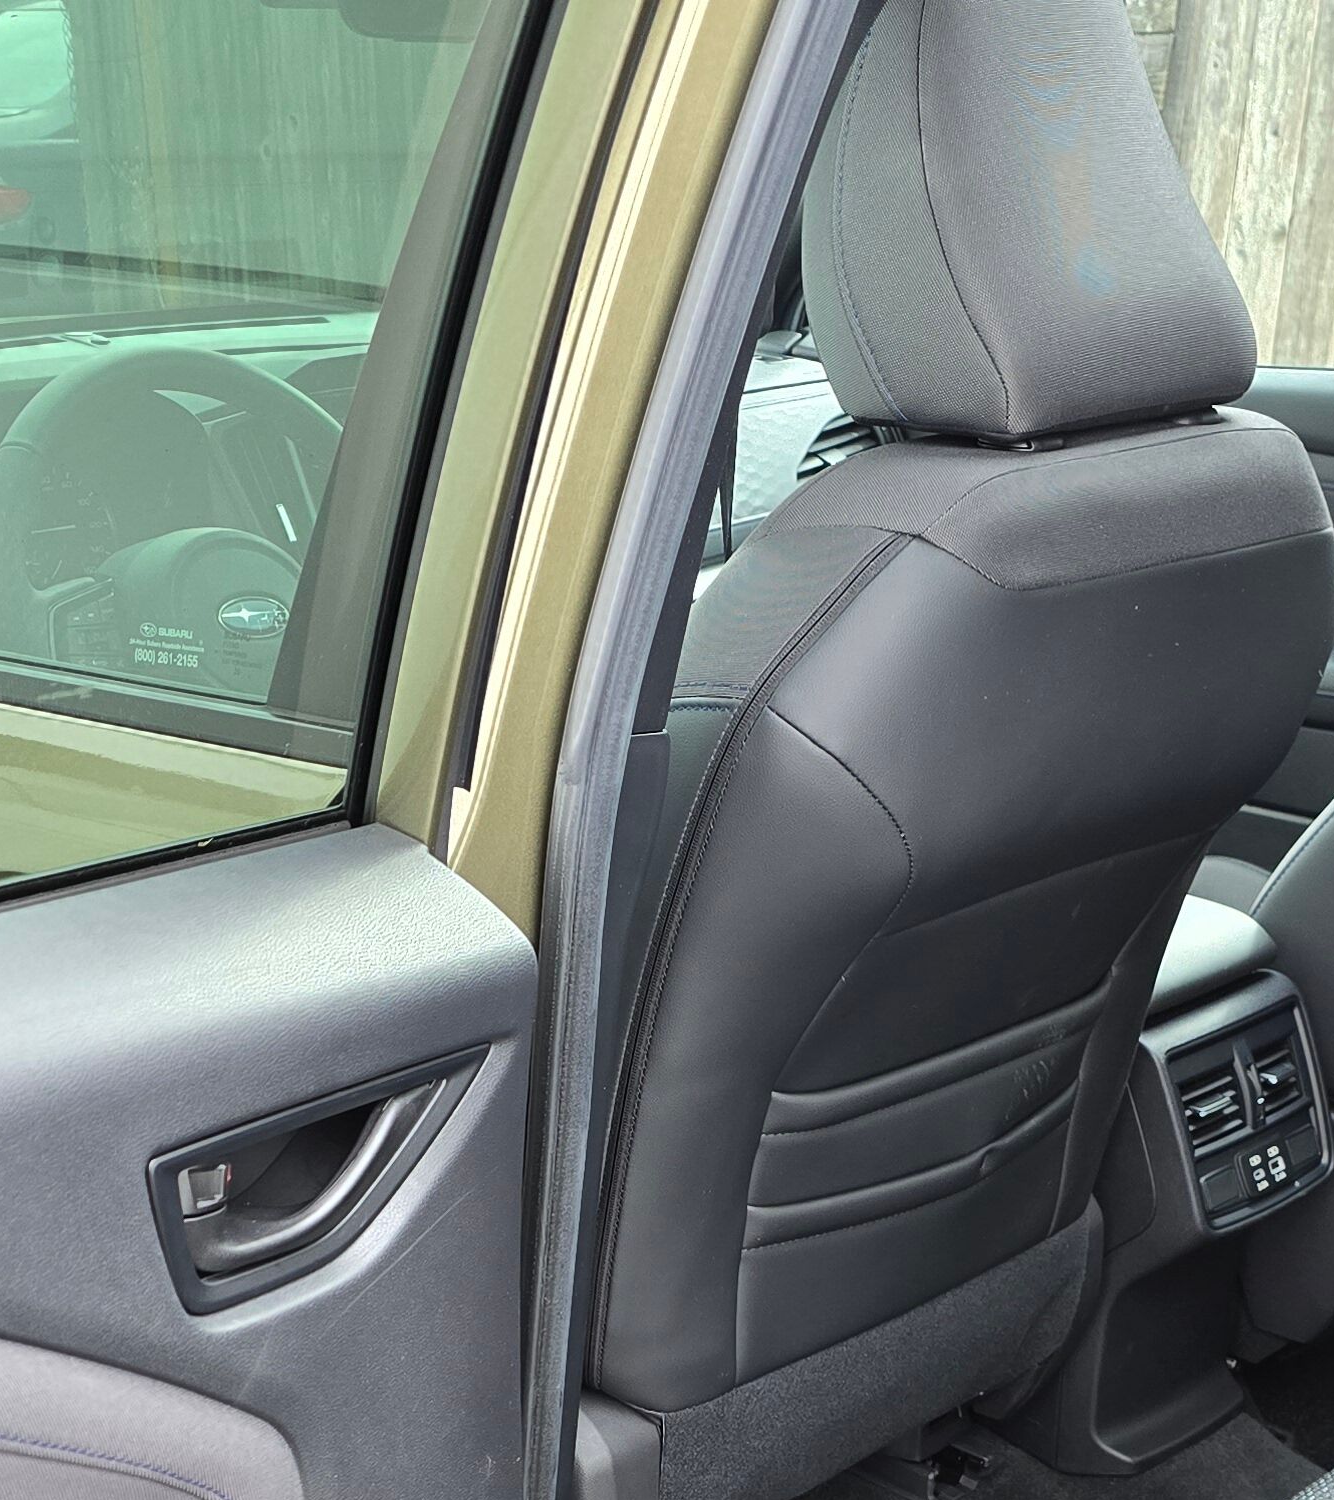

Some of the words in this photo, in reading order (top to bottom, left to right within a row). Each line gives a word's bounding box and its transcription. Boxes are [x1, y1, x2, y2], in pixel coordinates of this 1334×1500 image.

[158, 627, 193, 639] SUBARU
[134, 647, 156, 666] (800)
[157, 651, 199, 668] 261-2155
